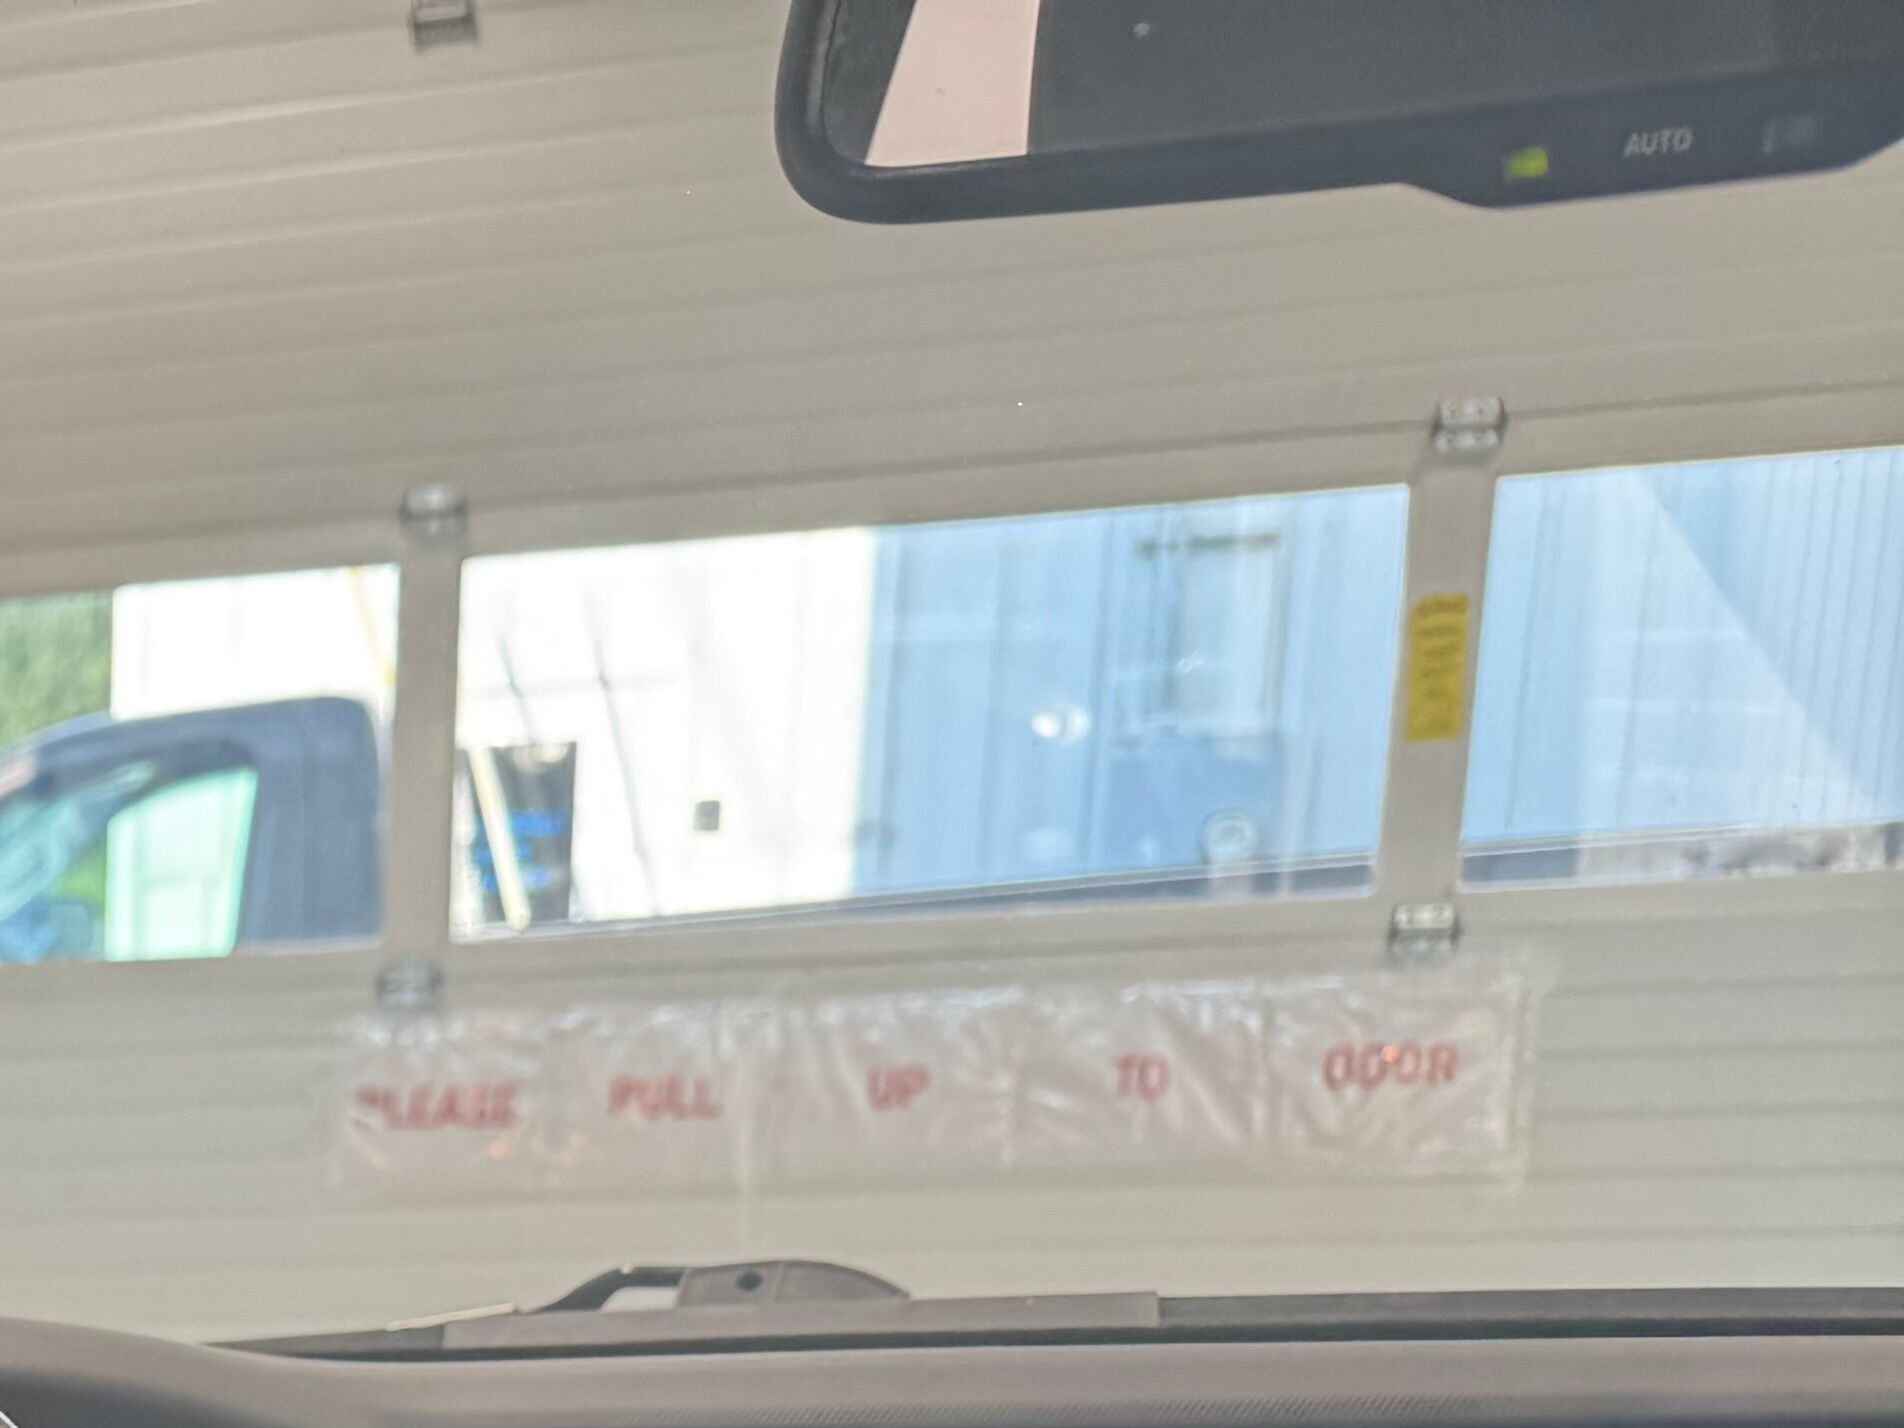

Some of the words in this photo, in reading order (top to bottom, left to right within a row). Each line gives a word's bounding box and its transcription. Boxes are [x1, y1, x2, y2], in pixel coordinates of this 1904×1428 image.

[1625, 127, 1692, 158] AUTO
[356, 1081, 517, 1129] PLEASE
[607, 1073, 722, 1120] PULL
[864, 1065, 933, 1110] UP
[1113, 1053, 1170, 1102] TO
[1322, 1041, 1460, 1091] DOOR
